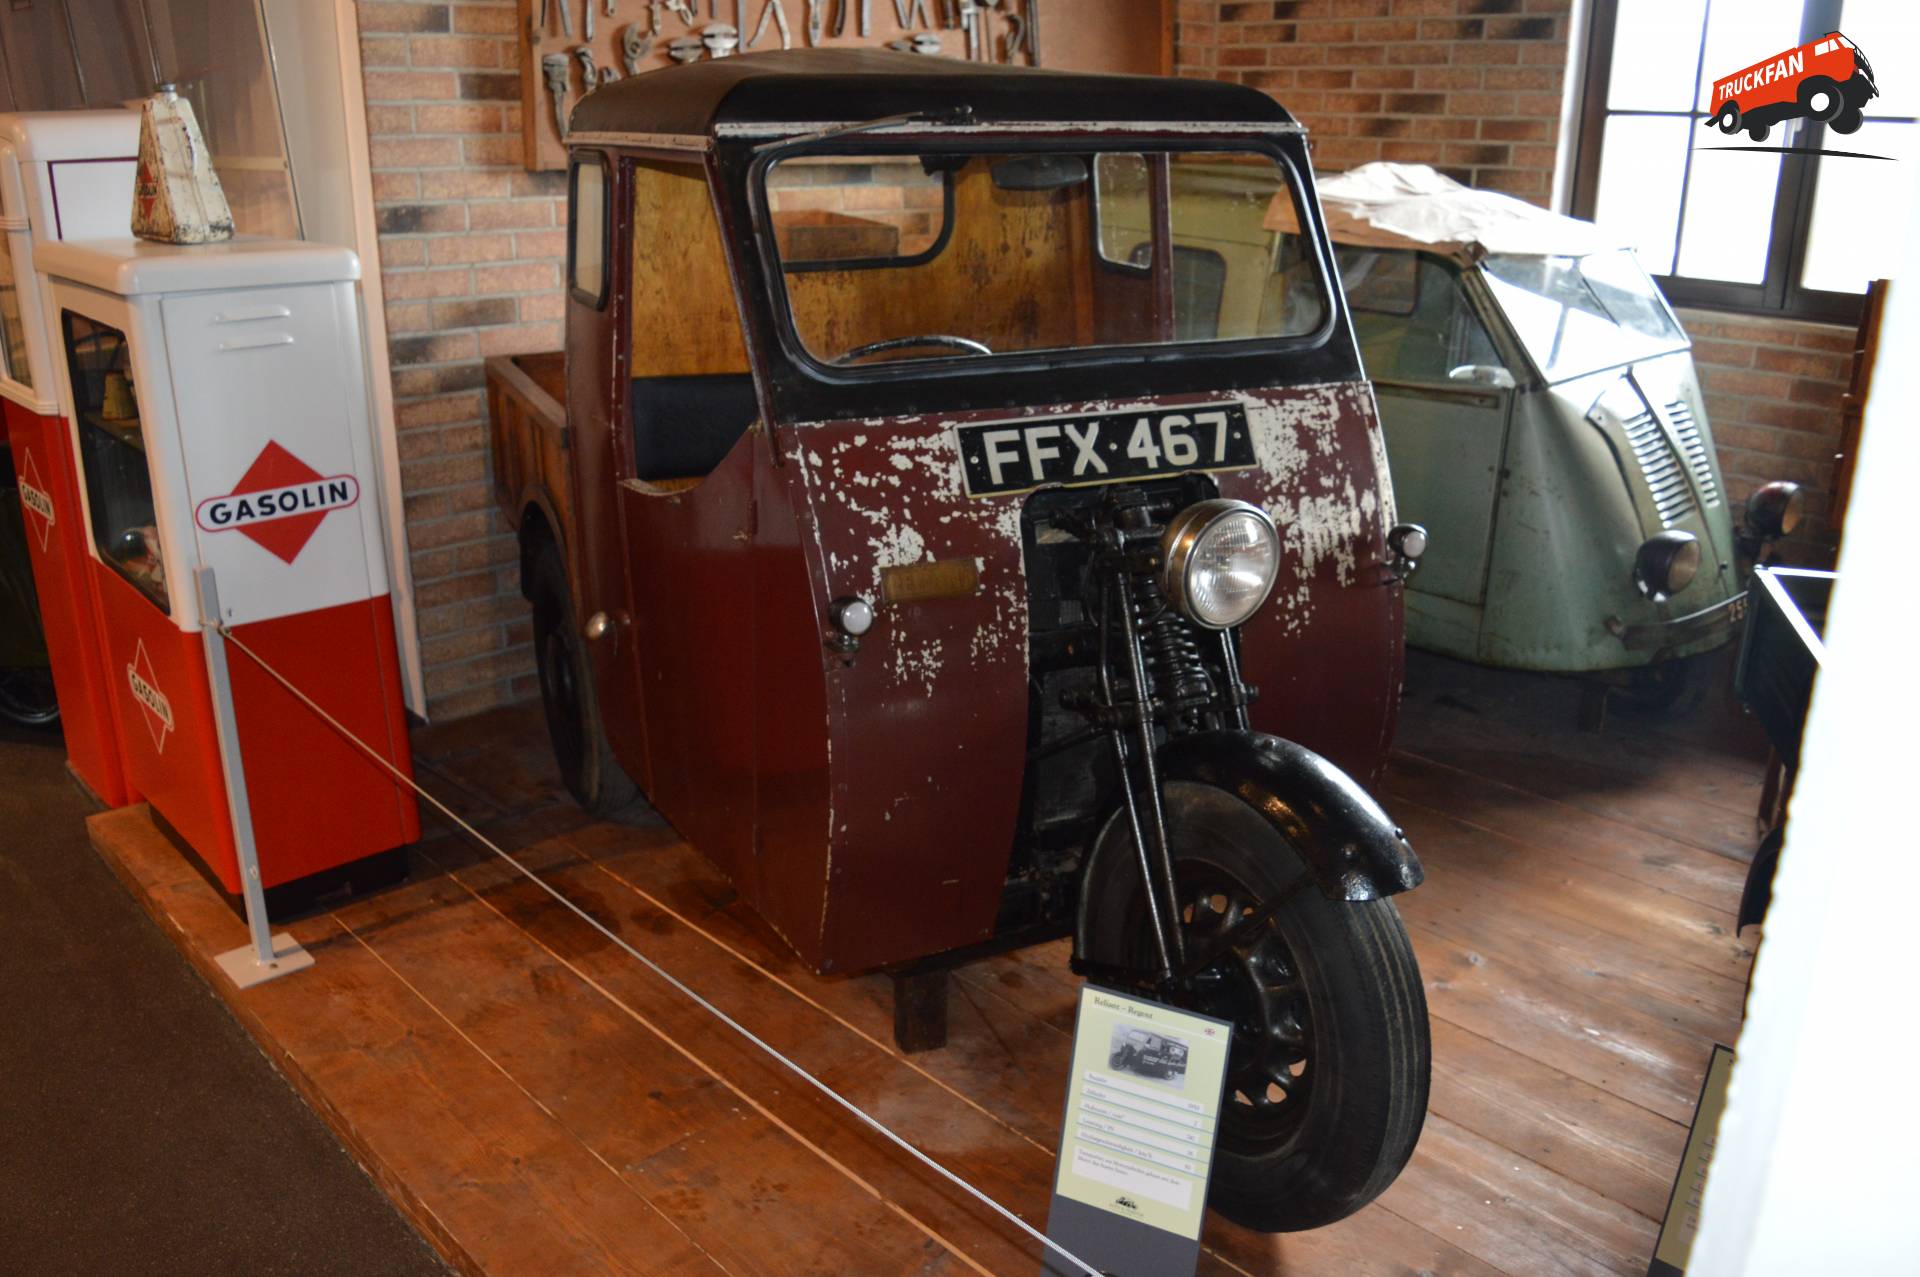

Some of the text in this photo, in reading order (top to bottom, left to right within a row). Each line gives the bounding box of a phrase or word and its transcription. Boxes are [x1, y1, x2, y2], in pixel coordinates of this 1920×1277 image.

[983, 411, 1228, 485] FFX 467
[21, 483, 51, 516] GASOLIN
[209, 481, 348, 525] GASOLIN
[131, 672, 170, 722] GASOLIN
